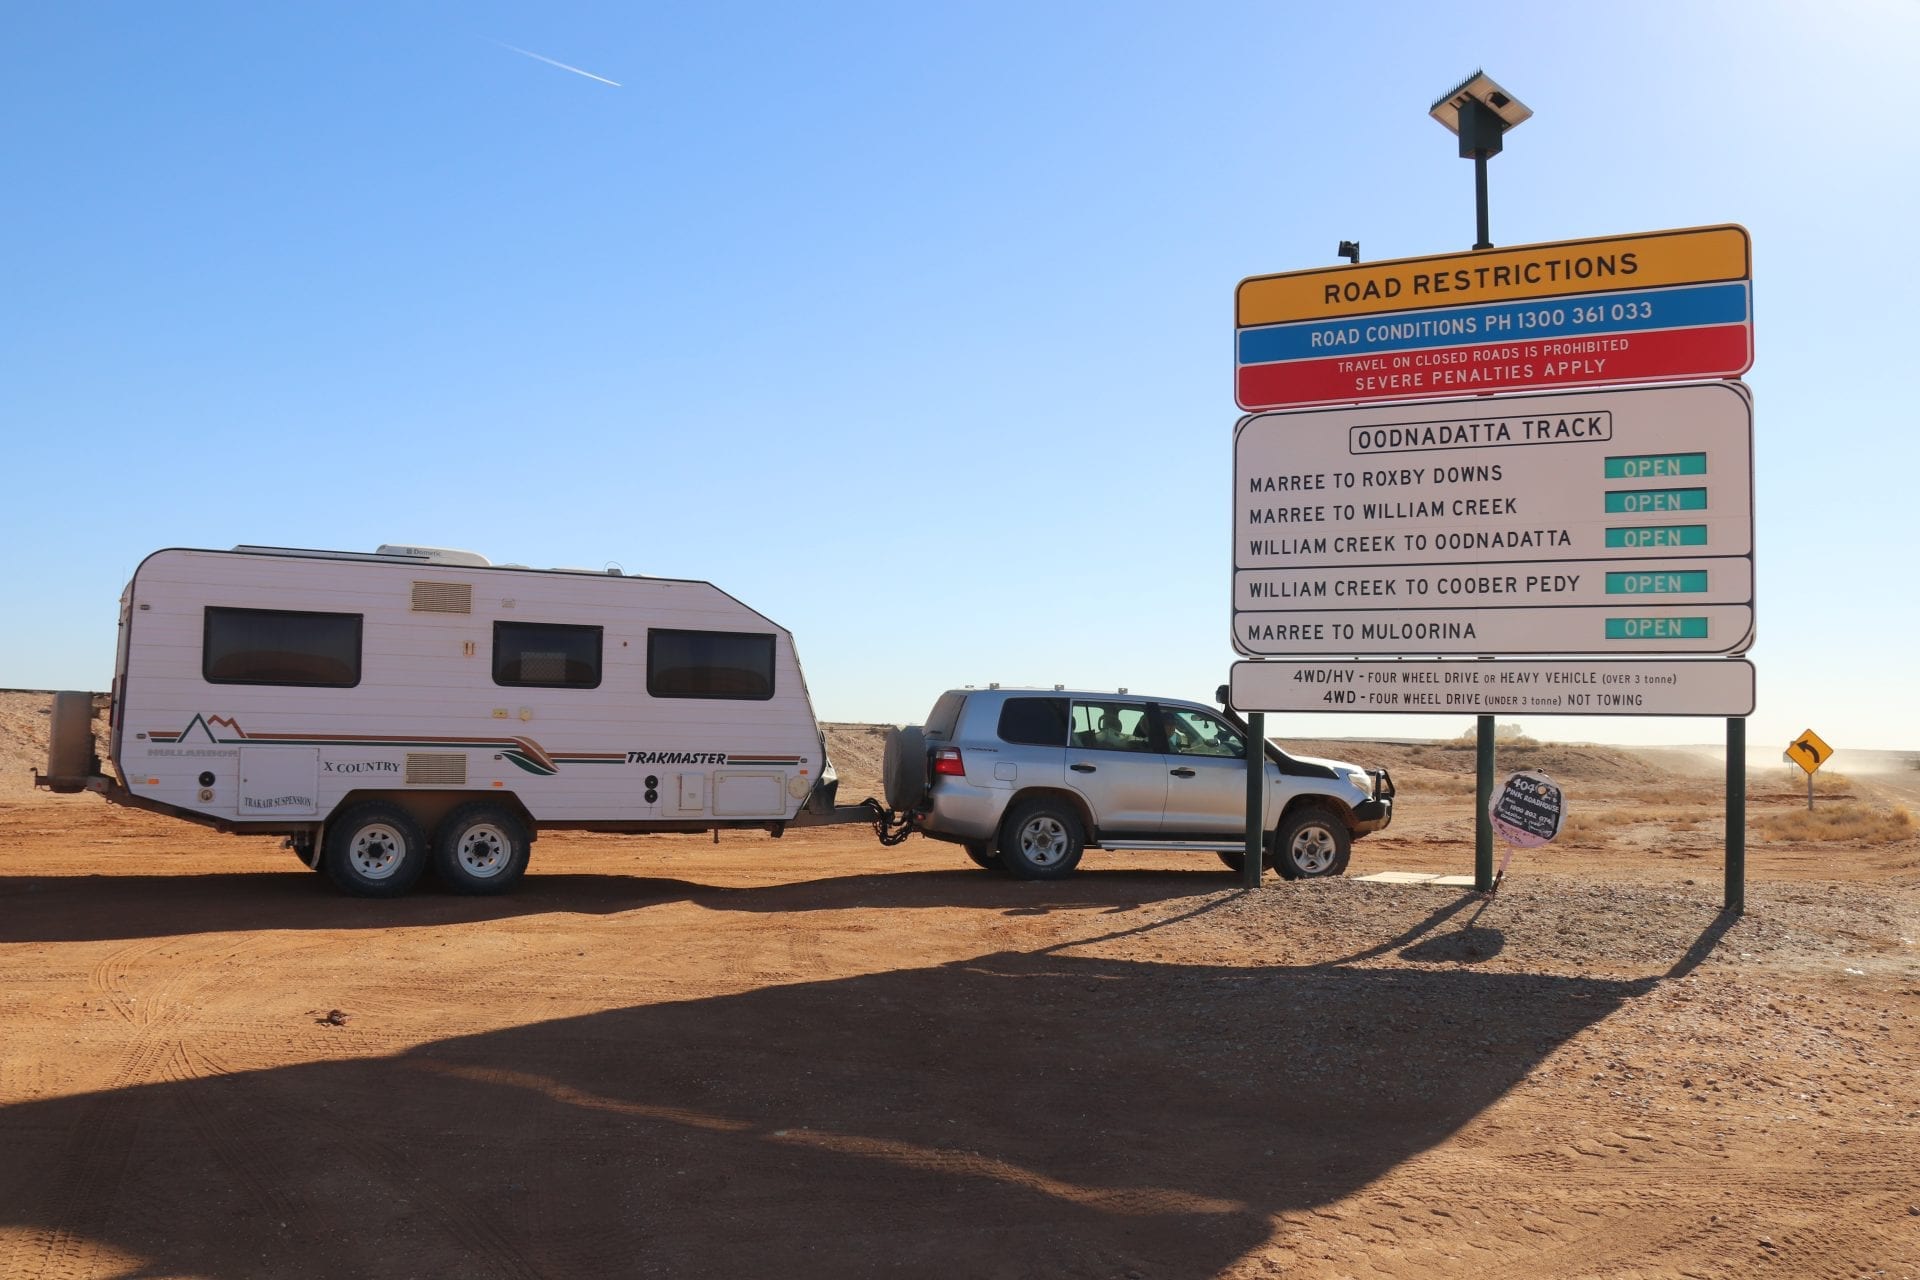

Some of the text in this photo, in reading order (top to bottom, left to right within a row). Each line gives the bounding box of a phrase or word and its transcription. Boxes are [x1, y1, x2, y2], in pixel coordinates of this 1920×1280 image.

[1325, 253, 1638, 304] ROAD RESTRICTIONS
[1312, 302, 1651, 347] ROAD CONDITIONS PH 1300 361 033
[1338, 339, 1628, 372] TRAVEL ON CLOSED ROADS IS PROHIBITED
[1356, 359, 1605, 390] SEVERE PENALTIES APPLY
[1358, 417, 1602, 449] OODNADATTA TRACK
[1623, 460, 1681, 478] OPEN
[1251, 465, 1501, 492] MARREE TO ROXBY DOWNS
[1251, 498, 1516, 524] MARREE TO WILLIAM CREEK
[1623, 494, 1682, 512] OPEN
[1251, 530, 1571, 555] WILLIAM CREEK TO OODNADATTA
[1624, 530, 1682, 547] OPEN
[1250, 576, 1579, 597] WILLIAM CREEK TO COOBER PEDY
[1624, 576, 1682, 593] OPEN
[1249, 623, 1475, 640] MARREE TO MULOORINA
[1624, 619, 1682, 636] OPEN
[1294, 670, 1354, 683] 4WD/HV
[1369, 673, 1396, 683] FOUR
[1403, 673, 1439, 683] WHEEL
[1445, 673, 1478, 683] DRIVE
[1484, 675, 1495, 683] OR
[1501, 672, 1539, 683] HEAVY
[1546, 672, 1596, 683] VEHICLE
[1603, 674, 1630, 684] (OVER
[1635, 675, 1640, 683] 3
[1645, 674, 1676, 684] tonne)
[1324, 691, 1355, 703] 4WD
[1370, 693, 1398, 704] FOUR
[1404, 694, 1440, 704] WHEEL
[1447, 694, 1480, 704] DRIVE
[1485, 695, 1517, 705] (UNDER
[1522, 697, 1526, 705] 3
[1531, 696, 1561, 706] tonne)
[1568, 694, 1590, 705] NOT
[1597, 695, 1642, 705] TOWING
[627, 751, 727, 764] TRAKMASTER
[324, 761, 401, 773] X COUNTRY
[1506, 787, 1523, 799] PINK
